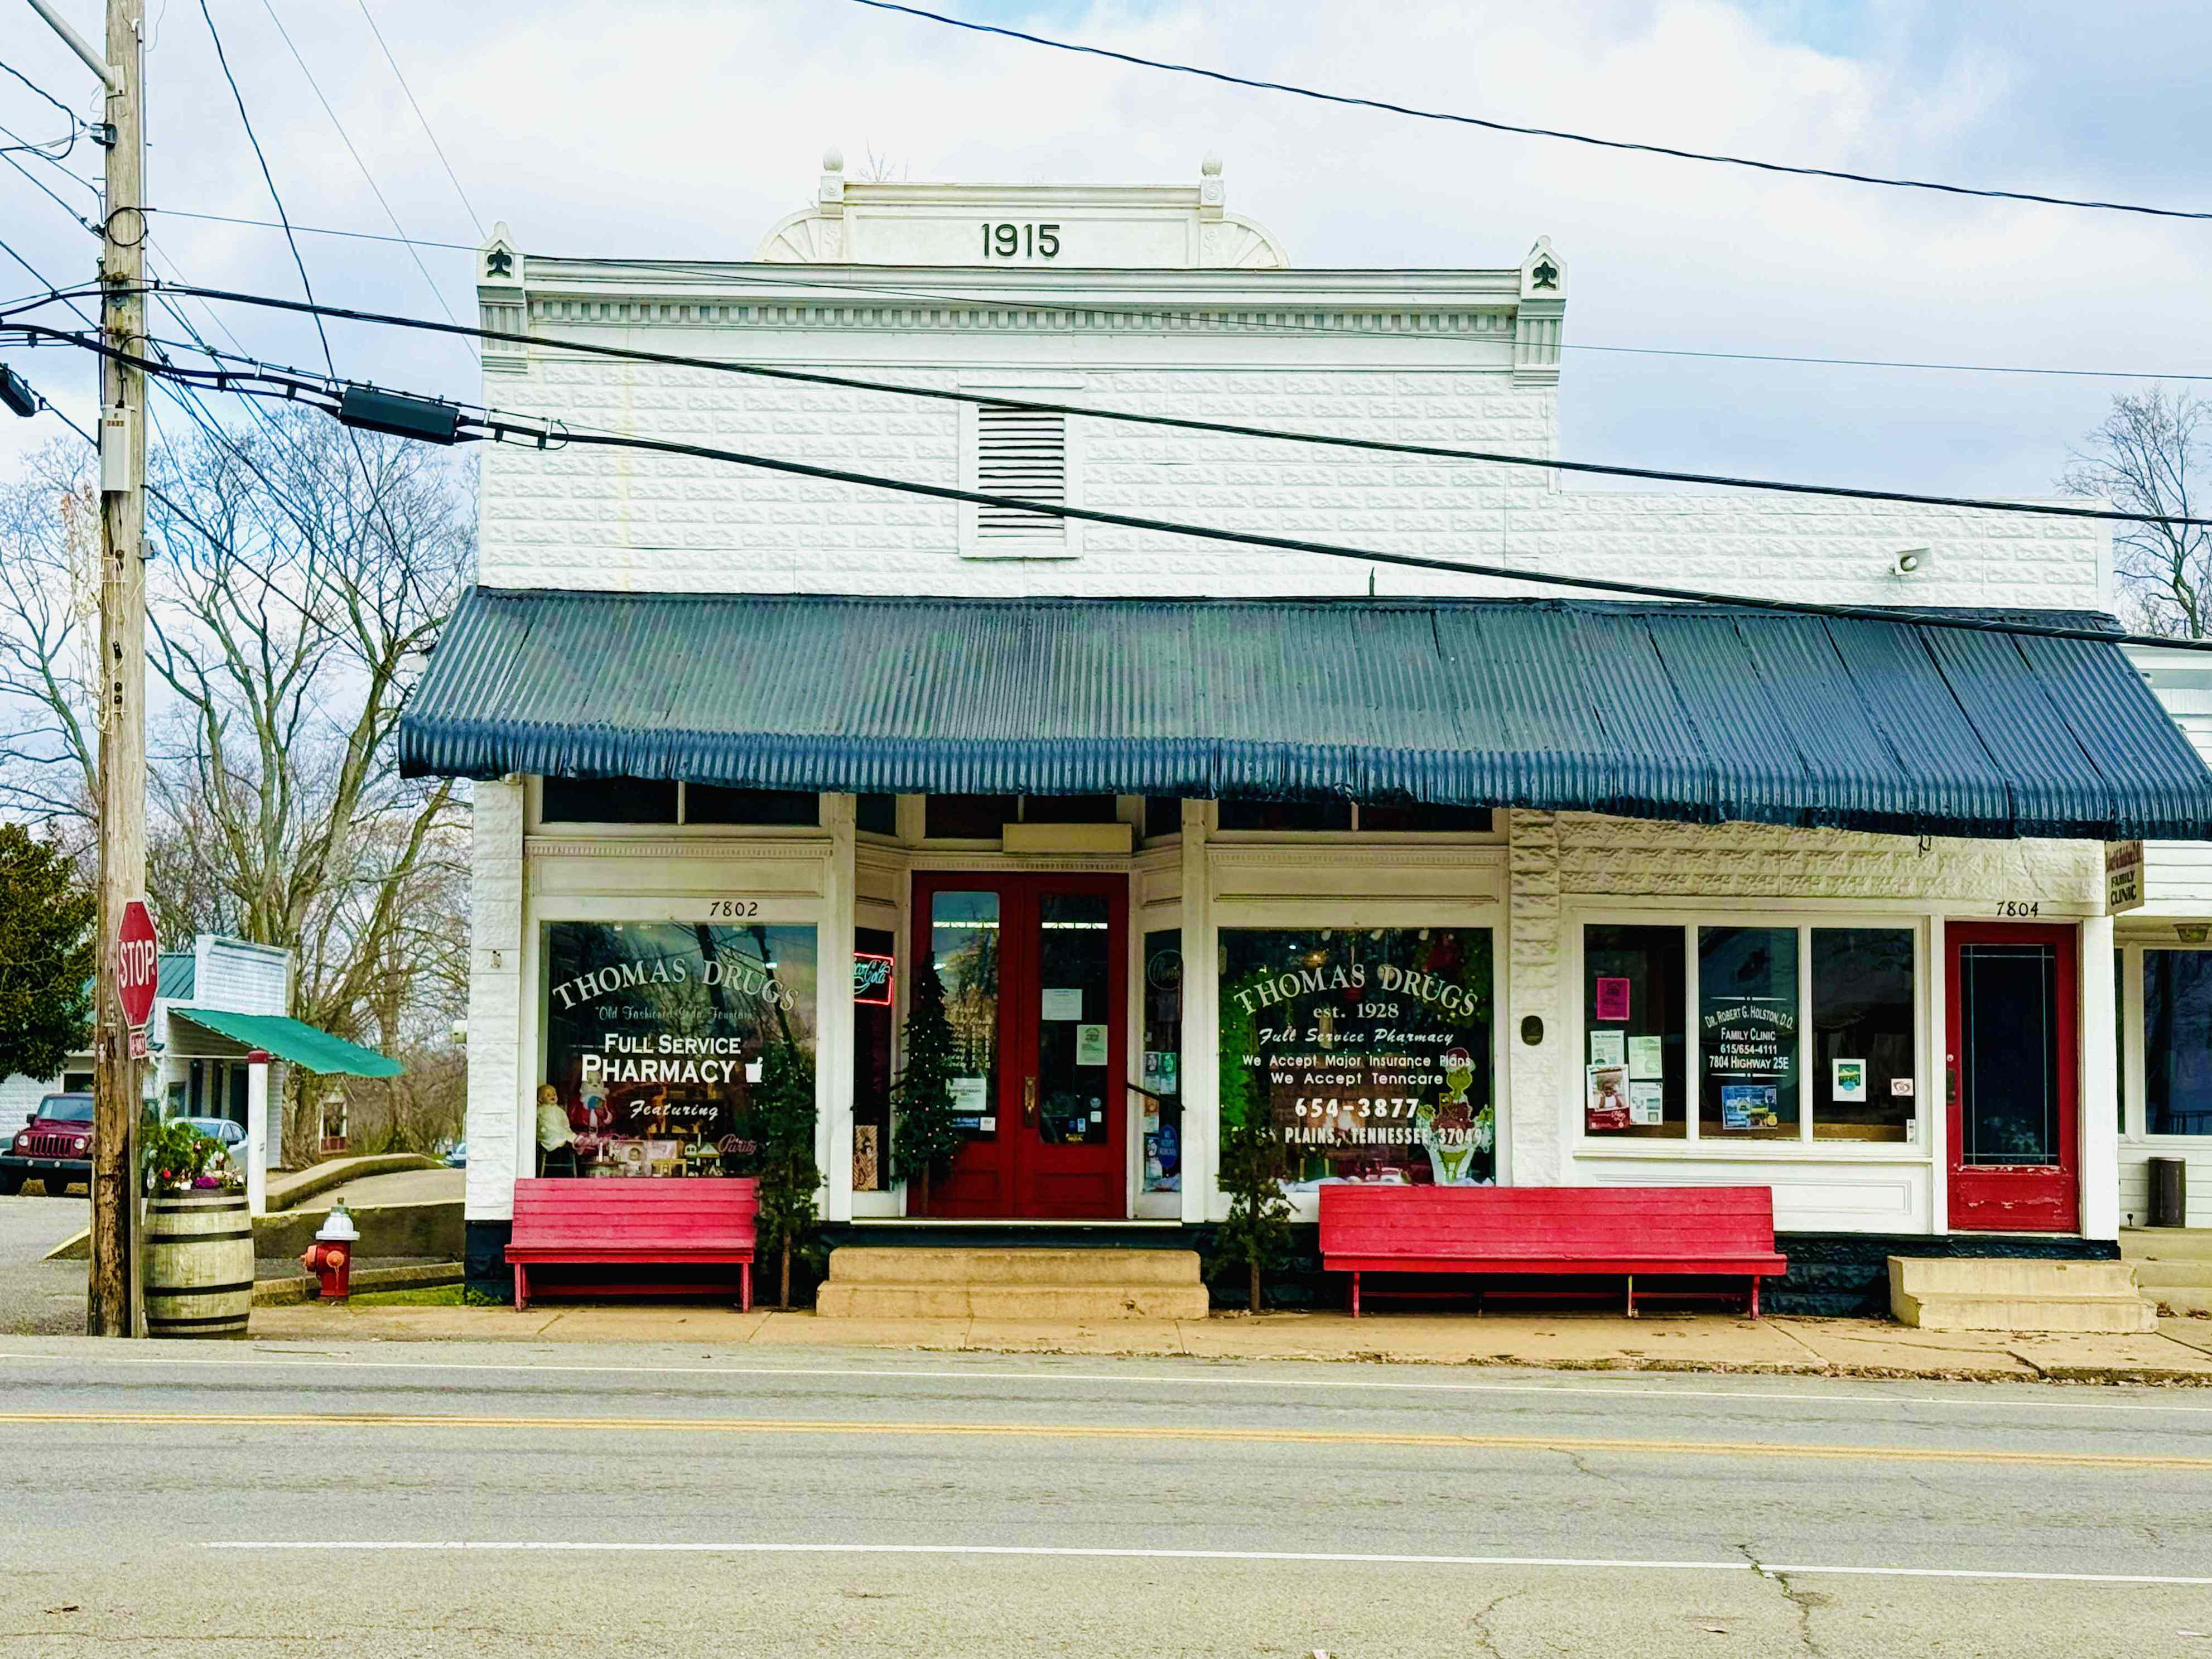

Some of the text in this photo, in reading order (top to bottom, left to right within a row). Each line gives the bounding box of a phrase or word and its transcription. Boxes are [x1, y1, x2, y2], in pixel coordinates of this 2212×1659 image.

[982, 224, 1060, 258] 1915
[2111, 870, 2135, 888] FAMILY
[2110, 884, 2137, 906] CLINIC
[710, 901, 758, 917] 7802
[1997, 900, 2038, 918] 7804
[119, 939, 155, 988] STOP
[552, 958, 799, 1011] THOMAS DRUGS
[1233, 963, 1366, 1016] THOMAS
[1380, 965, 1478, 1016] DRUGS
[1313, 1003, 1399, 1019] est. 1928
[1717, 1008, 1741, 1023] ROBERT
[1742, 1005, 1750, 1018] G.
[1259, 1028, 1454, 1046] Full Service Pharmacy
[1721, 1027, 1776, 1041] FAMILY CLINIC
[605, 1033, 741, 1054] FULL SERVICE
[1720, 1044, 1777, 1054] 615/654-4111
[581, 1054, 736, 1083] PHARMACY
[1242, 1054, 1471, 1069] We Accept Major Insurance Plans
[1709, 1055, 1789, 1069] 7804 HIGHWAY 25E
[1270, 1072, 1443, 1087] We Accept Tenncare
[629, 1100, 719, 1121] Featuring
[1294, 1098, 1419, 1118] 654-3877
[1285, 1127, 1341, 1147] PLAINS,
[1351, 1127, 1428, 1144] TENNESSEE
[1438, 1127, 1482, 1145] 37049
